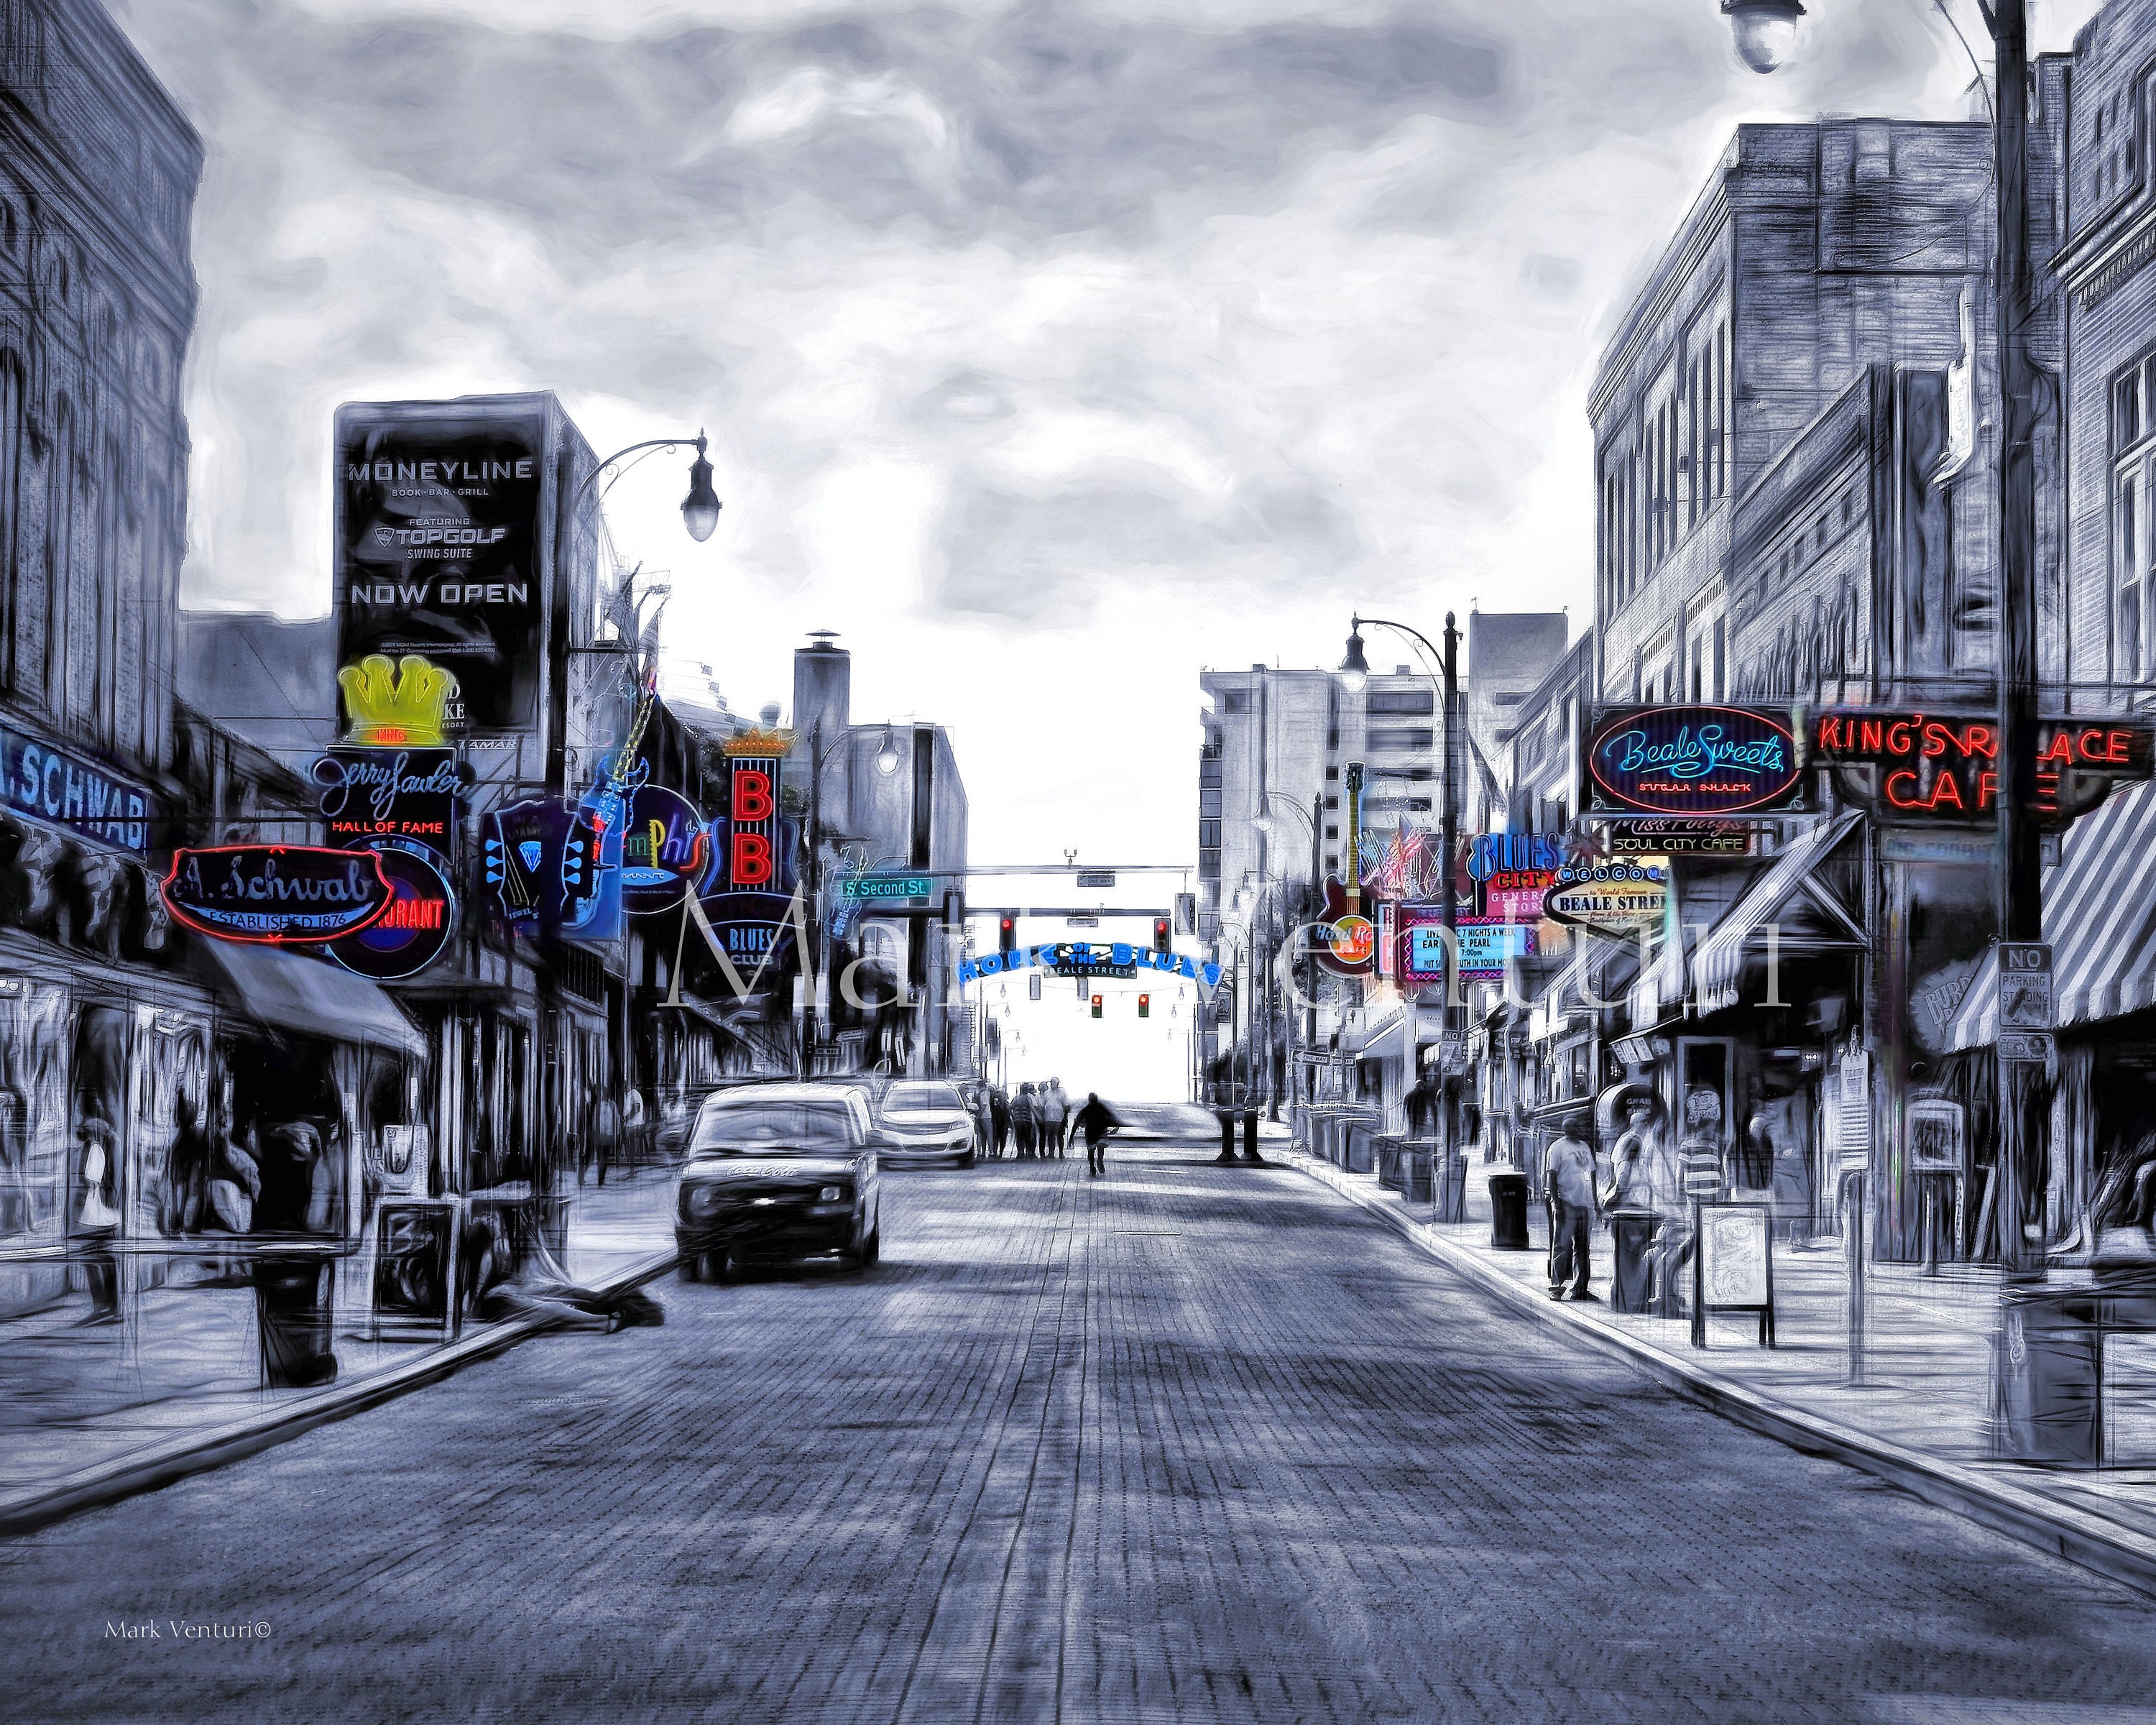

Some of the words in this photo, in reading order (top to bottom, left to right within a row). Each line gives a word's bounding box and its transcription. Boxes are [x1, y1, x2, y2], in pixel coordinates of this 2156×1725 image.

[348, 460, 533, 481] MONEYLINE
[396, 528, 505, 545] TOPGOLF
[407, 548, 441, 558] SWING
[443, 548, 472, 558] SUITE
[351, 584, 428, 604] NOW
[441, 584, 528, 603] OPEN
[377, 729, 407, 741] KING
[1818, 714, 1946, 758] KING'S
[1606, 724, 1702, 771] Beale
[1679, 724, 1784, 778] Sweets
[313, 758, 393, 818] Jerry
[373, 752, 469, 821] Lawler
[21, 745, 144, 850] SCHWAB
[333, 822, 372, 832] HALL
[374, 822, 395, 833] OF
[402, 822, 444, 834] FAME
[1613, 839, 1659, 850] SOUL
[1662, 838, 1697, 850] CITY
[1700, 838, 1744, 850] CAFE
[1478, 832, 1560, 883] BLUES
[172, 856, 214, 898] A.
[221, 855, 374, 901] Schwab
[1494, 871, 1556, 888] CITY
[1561, 867, 1660, 880] WELCOM
[861, 881, 906, 896] Second
[908, 880, 926, 894] St.
[1491, 891, 1539, 902] GENER
[1503, 902, 1539, 913] STOR
[1559, 897, 1612, 911] BEALE
[210, 912, 313, 930] ESTABLISHED
[318, 914, 347, 928] 1876
[1354, 925, 1374, 944] Ro
[1468, 928, 1491, 937] NIGHTS
[1498, 927, 1516, 937] WEEK
[729, 928, 774, 952] BLUES
[1469, 938, 1491, 947] PEARL
[1073, 943, 1092, 953] OF
[1340, 946, 1368, 955] CAFE
[1461, 949, 1483, 957] 7:00pm
[730, 954, 774, 965] CLUB
[956, 944, 1059, 983] HOME
[1068, 953, 1097, 965] THE
[1111, 942, 1222, 986] BLUES
[1424, 960, 1435, 968] PUT
[1472, 959, 1479, 967] IN
[1480, 958, 1496, 967] YOUR
[2008, 948, 2041, 968] NO
[1049, 967, 1085, 976] BEALE
[1087, 966, 1130, 977] STREET
[2002, 975, 2045, 987] PARKING
[2002, 990, 2049, 1002] STDING
